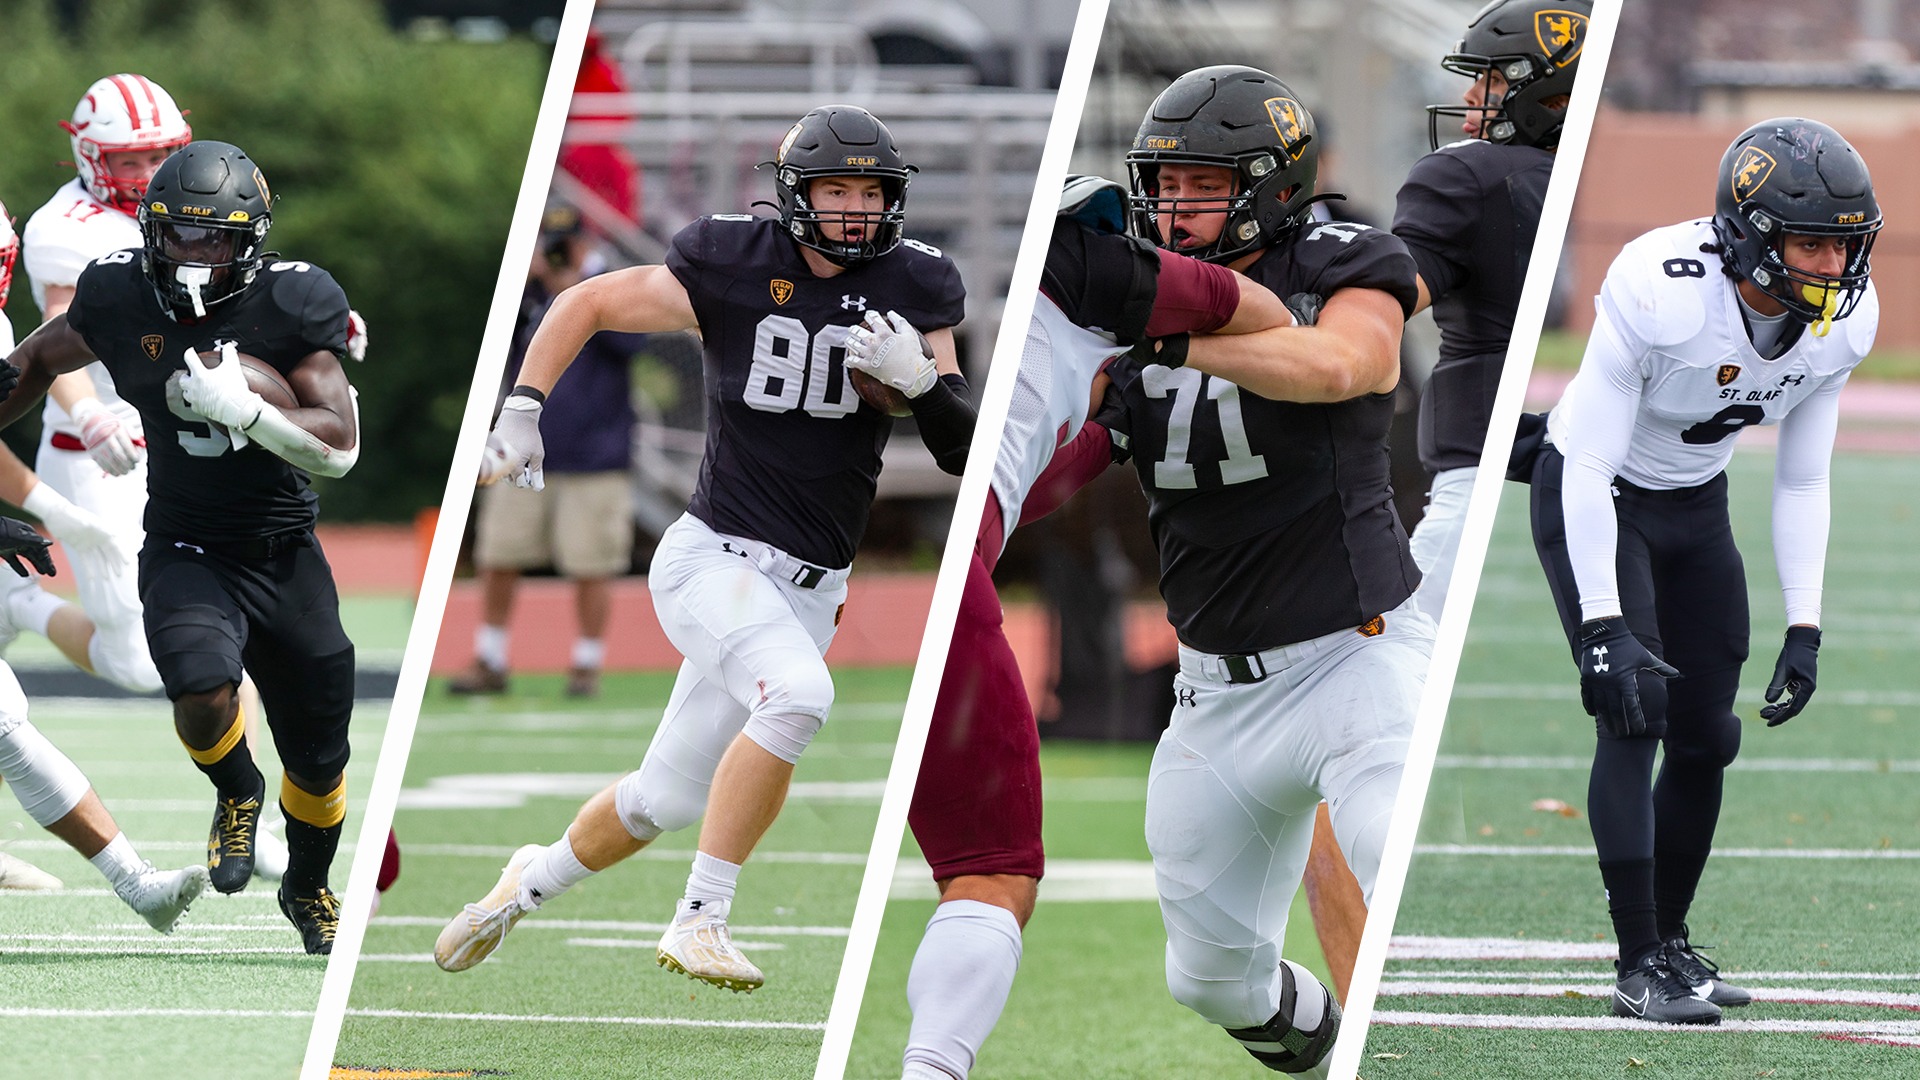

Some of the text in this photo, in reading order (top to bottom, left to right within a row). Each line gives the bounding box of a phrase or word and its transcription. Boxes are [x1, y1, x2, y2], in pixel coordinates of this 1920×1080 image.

[64, 199, 104, 223] 17
[1662, 258, 1706, 278] 8
[743, 313, 860, 419] 80
[1719, 388, 1782, 402] ST. OLAF
[1141, 363, 1269, 490] 71
